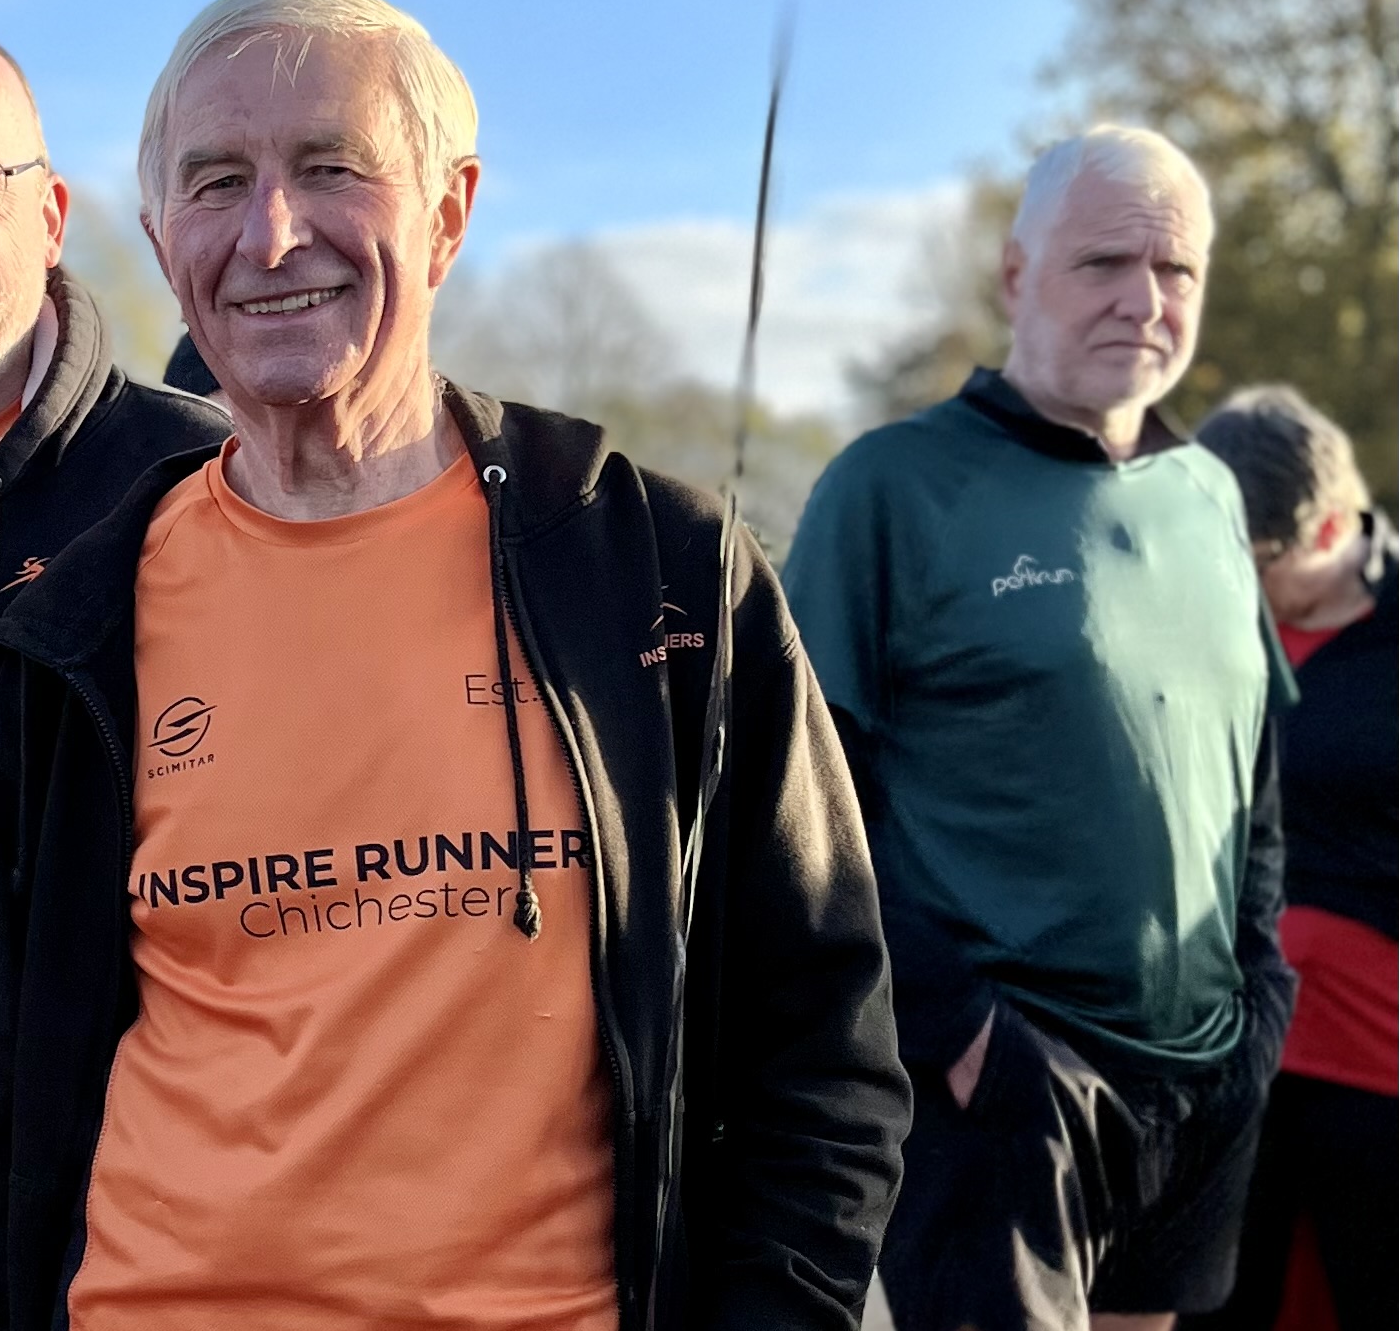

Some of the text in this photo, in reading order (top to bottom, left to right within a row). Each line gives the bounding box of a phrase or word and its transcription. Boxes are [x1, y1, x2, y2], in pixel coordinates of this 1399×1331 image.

[147, 753, 215, 779] SCIMITAR
[139, 829, 588, 909] INSPIRE RUNNER
[239, 882, 512, 938] Chichester
